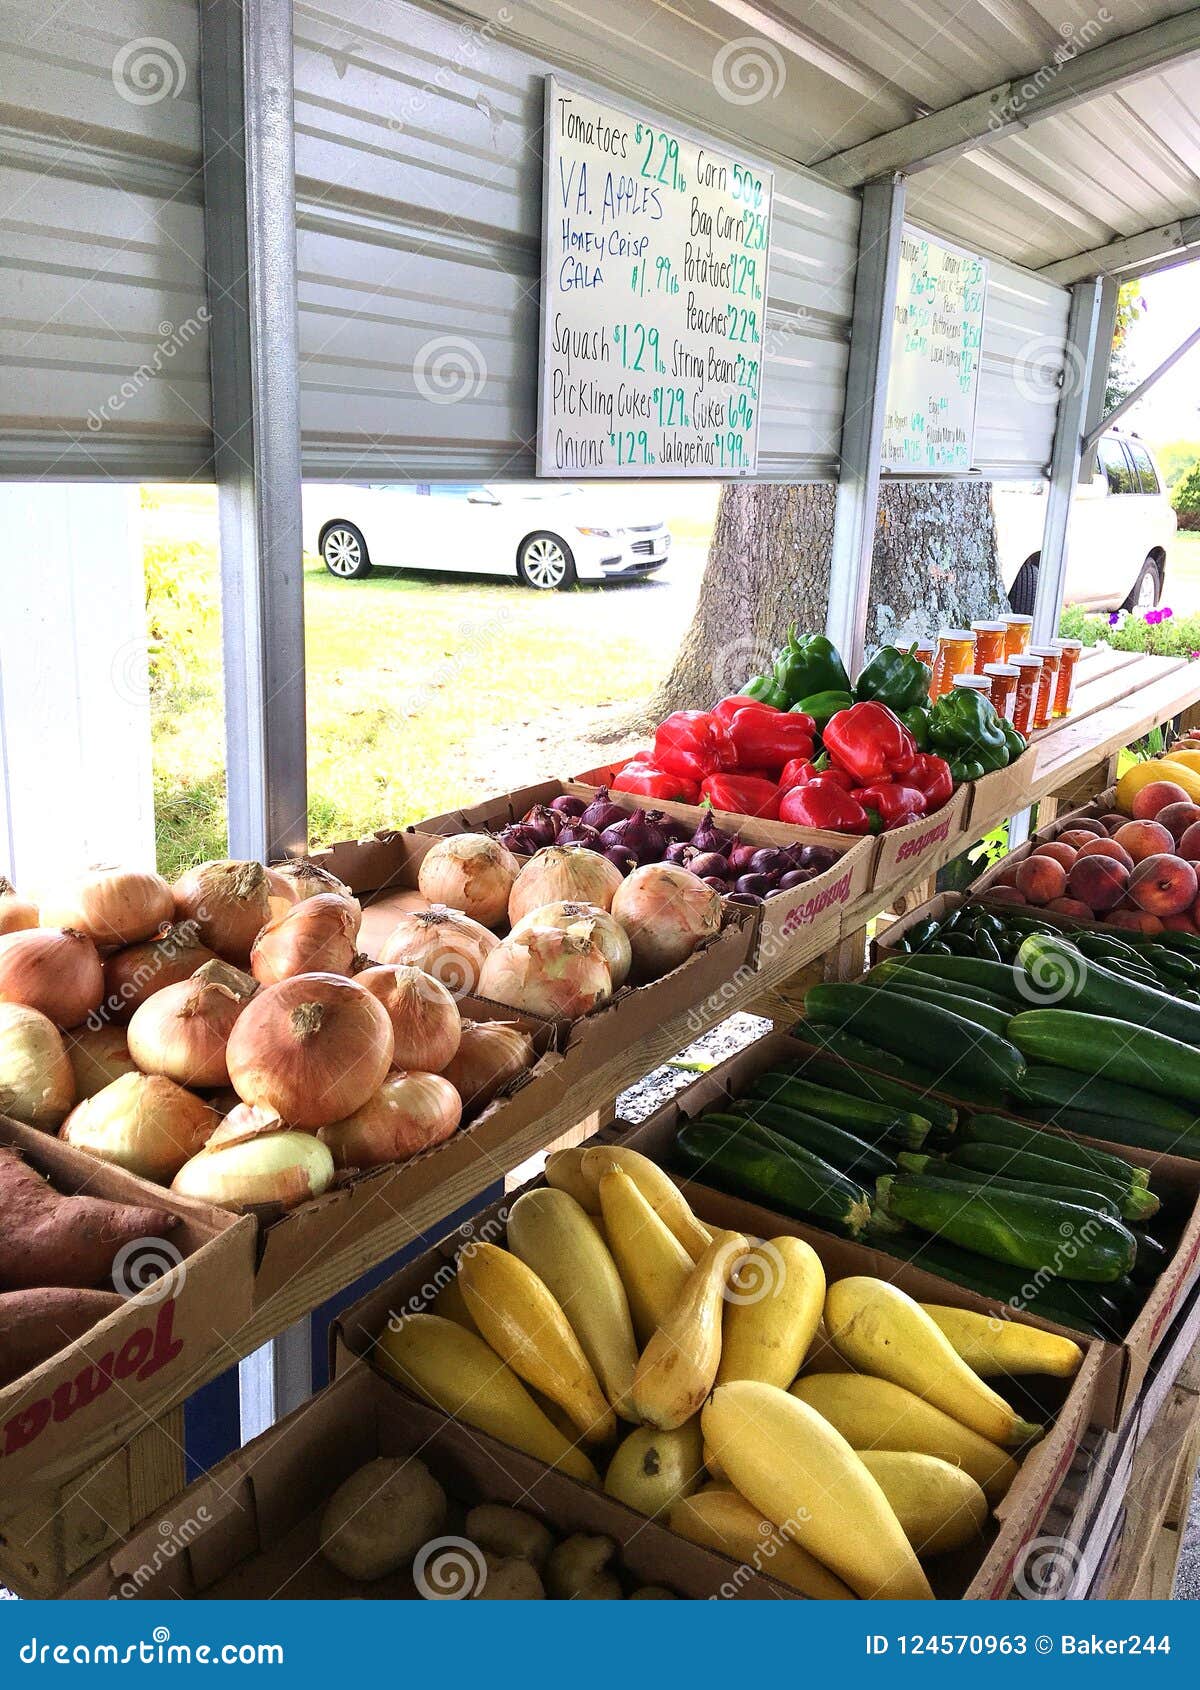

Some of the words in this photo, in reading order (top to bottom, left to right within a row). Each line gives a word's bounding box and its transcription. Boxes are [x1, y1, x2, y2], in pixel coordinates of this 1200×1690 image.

[558, 98, 629, 159] Tomatoes
[696, 150, 727, 192] Corn
[601, 171, 664, 225] APPLES
[689, 196, 713, 257] Bag
[716, 206, 745, 243] Corn
[559, 255, 604, 292] GALA
[683, 241, 731, 290] Potatoes
[686, 291, 729, 337] Peaches
[551, 312, 610, 376] Squash
[671, 338, 704, 392] String
[707, 346, 738, 384] Beans
[552, 367, 615, 436] Pickling
[617, 382, 652, 420] Cukes
[692, 390, 726, 431] Cukes
[555, 427, 605, 470] Onions
[659, 431, 716, 468] Jalapeños
[0, 1299, 185, 1457] Toma
